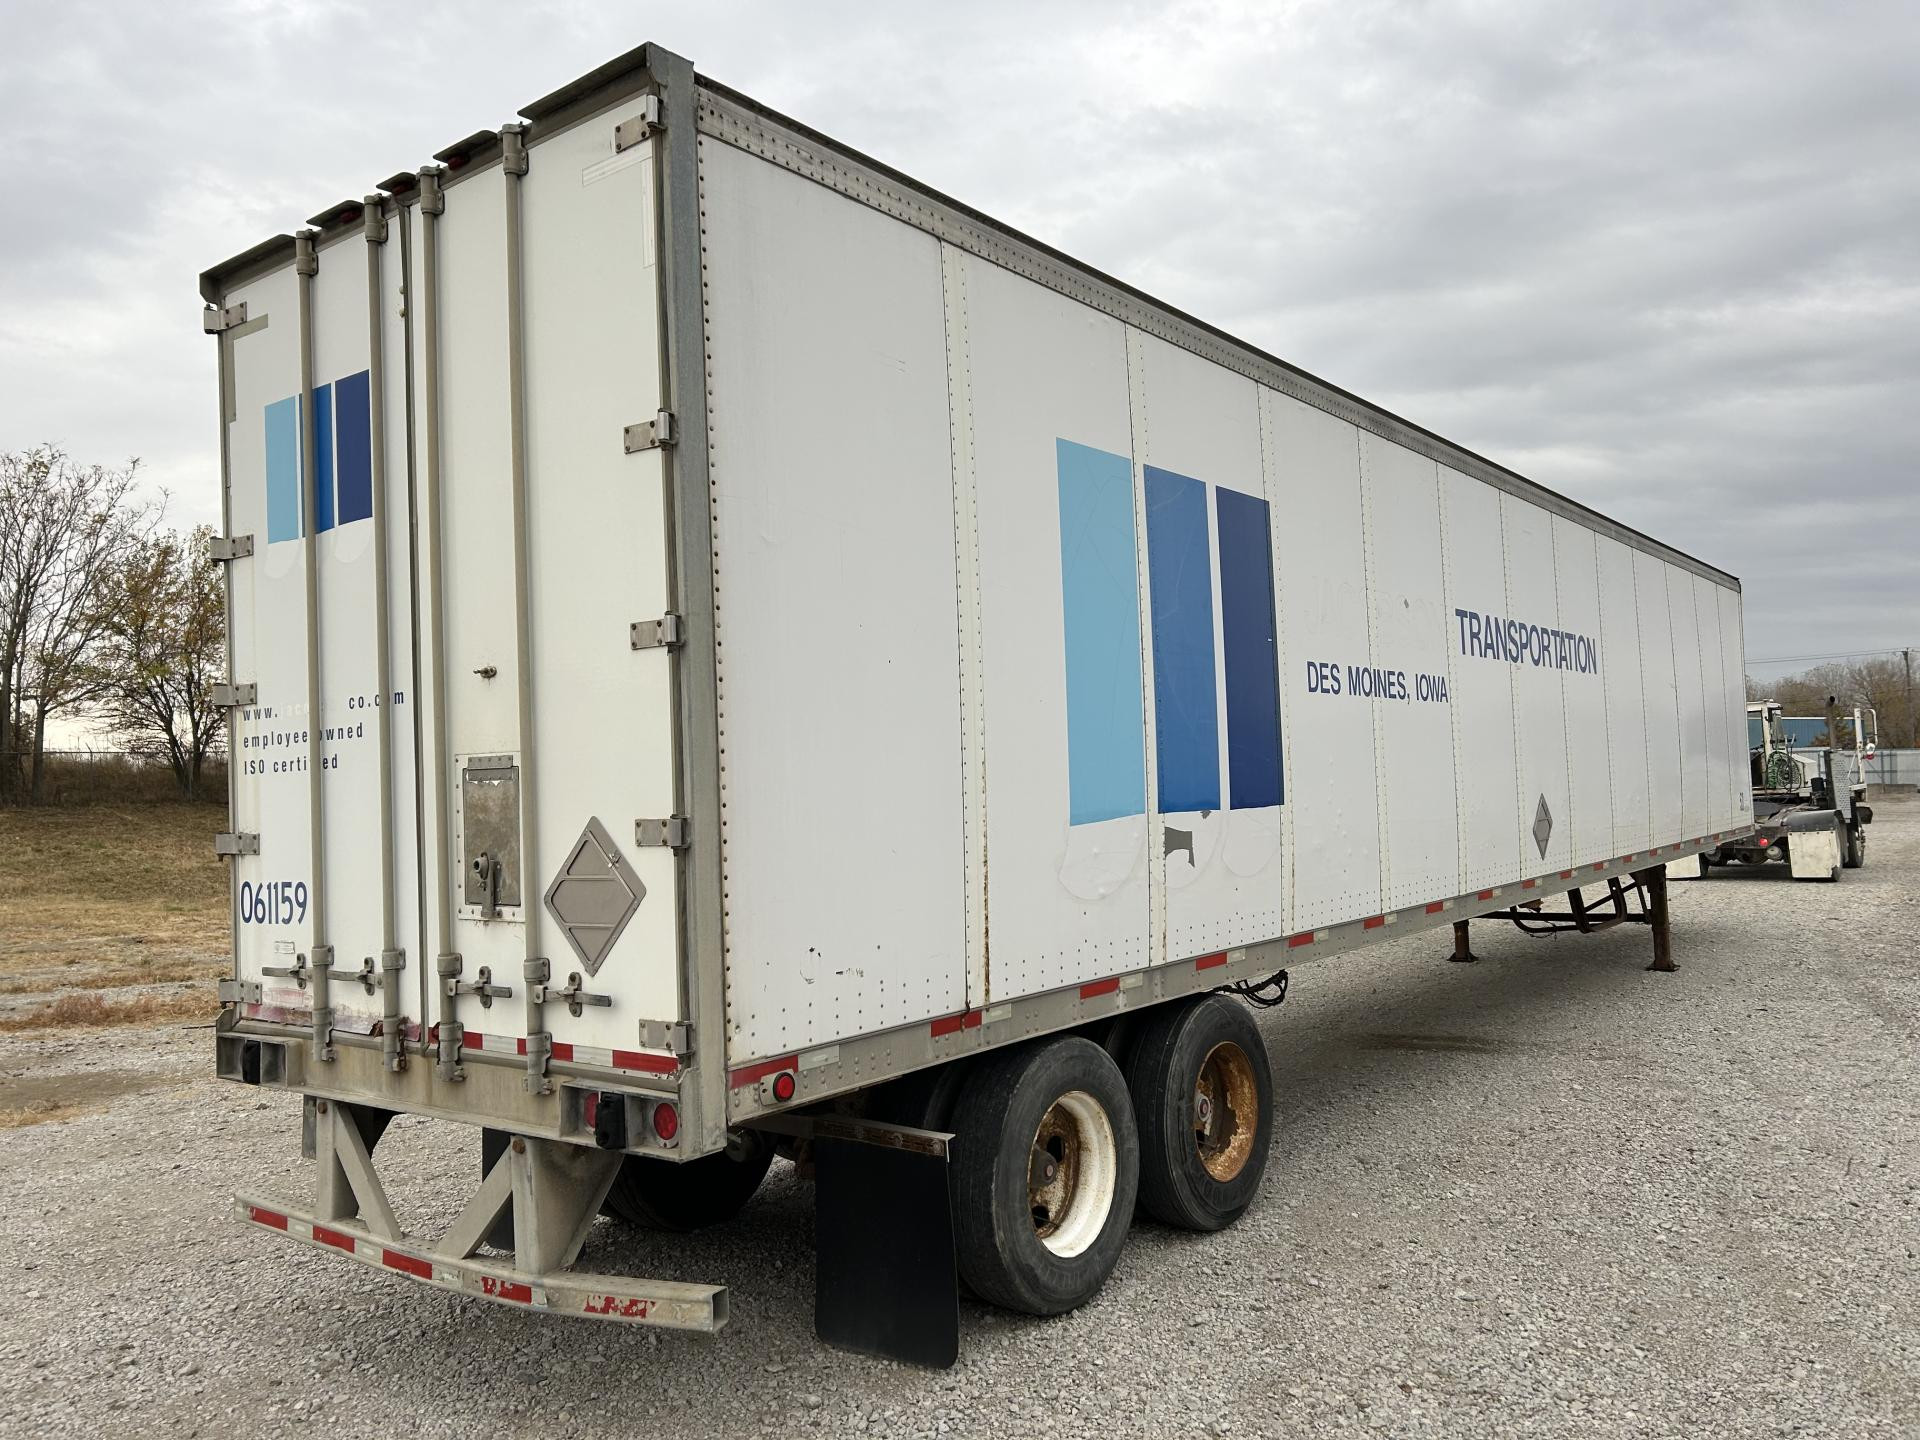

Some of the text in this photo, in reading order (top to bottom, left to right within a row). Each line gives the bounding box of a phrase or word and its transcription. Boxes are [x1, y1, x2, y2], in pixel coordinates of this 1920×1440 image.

[1454, 608, 1598, 675] TRANSPORTATION
[1306, 661, 1449, 704] DES MOINES, IOWA
[243, 730, 308, 750] employee
[244, 753, 338, 775] ISO certied
[240, 880, 308, 925] 061159
